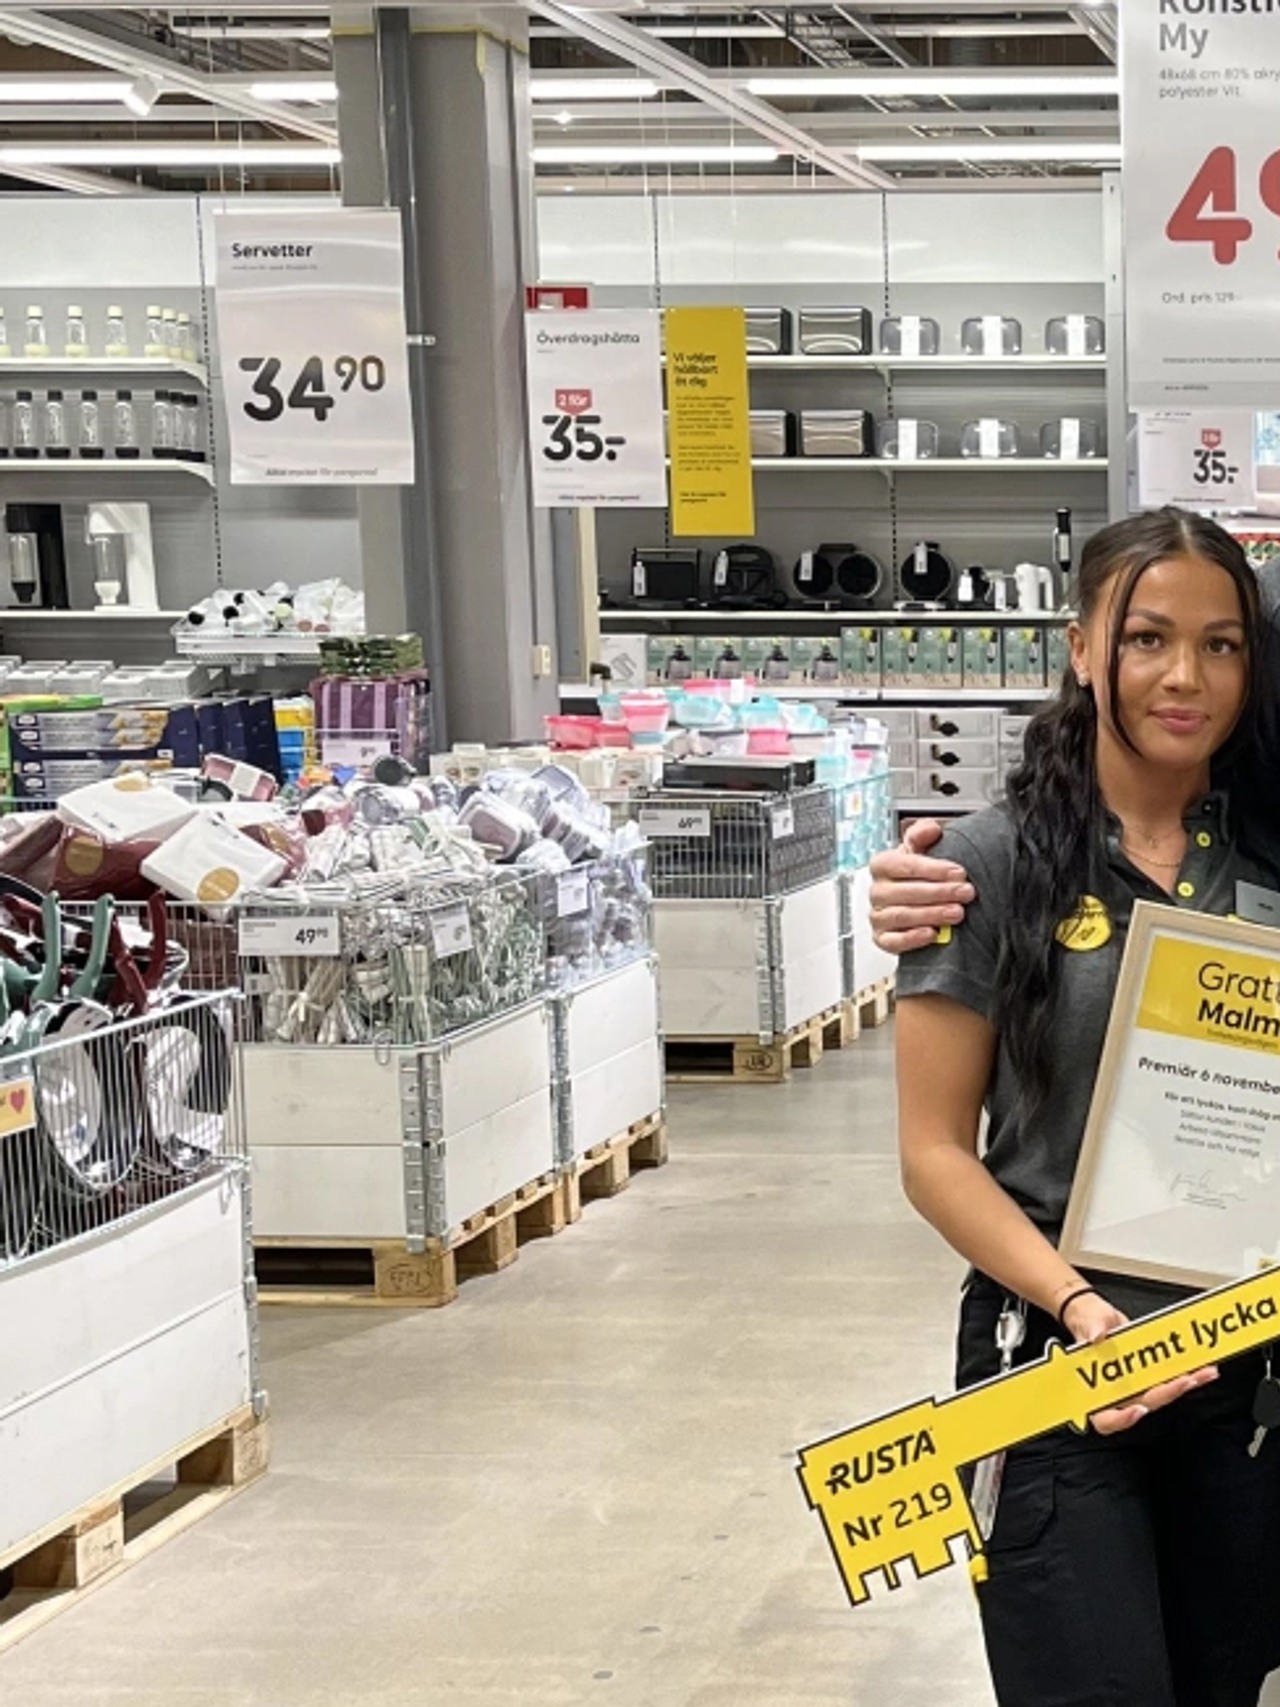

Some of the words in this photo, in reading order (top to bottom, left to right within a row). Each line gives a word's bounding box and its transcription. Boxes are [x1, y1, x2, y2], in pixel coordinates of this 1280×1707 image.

[1159, 22, 1209, 58] My
[1199, 69, 1221, 80] cm
[1159, 84, 1219, 99] polyester
[231, 242, 314, 258] Servetter
[536, 330, 640, 346] Överdragshätta
[558, 394, 567, 406] 2
[1138, 1057, 1198, 1079] Premiär
[1201, 1068, 1210, 1082] 6
[1077, 1331, 1186, 1389] Varmt
[1191, 1296, 1278, 1348] lycka
[825, 1429, 936, 1494] RUSTA
[843, 1514, 883, 1547] Nr
[889, 1483, 953, 1529] 219
